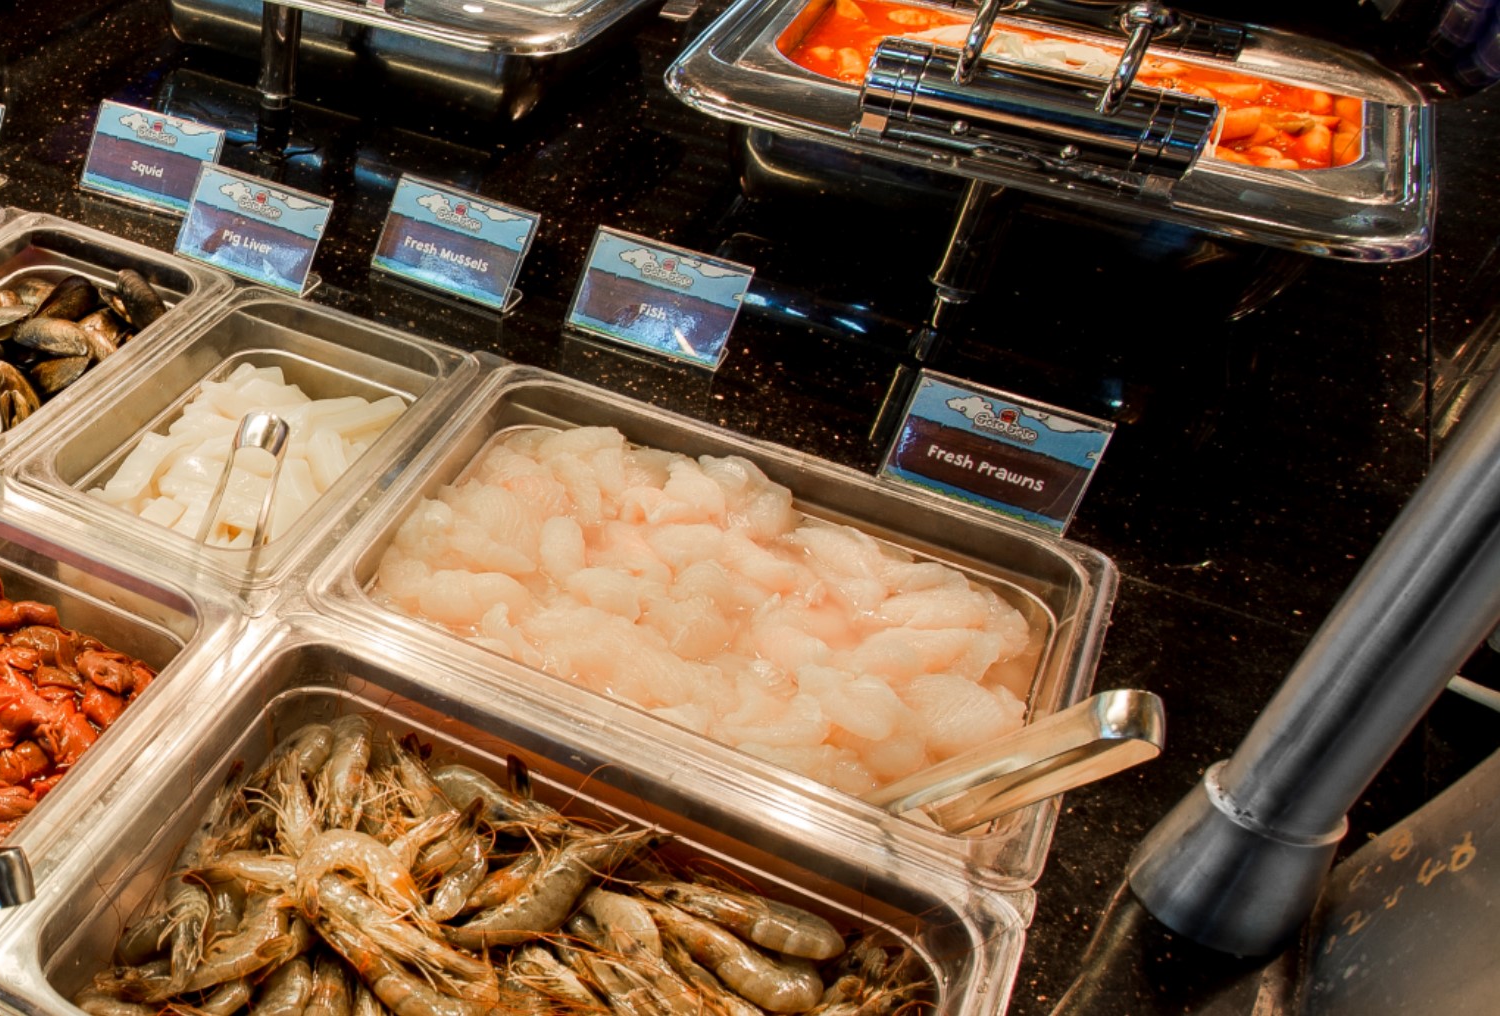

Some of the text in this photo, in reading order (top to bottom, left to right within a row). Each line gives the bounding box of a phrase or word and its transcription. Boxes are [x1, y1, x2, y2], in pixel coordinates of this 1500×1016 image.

[130, 160, 163, 178] Squid
[222, 229, 272, 254] Pig Liver
[403, 235, 489, 273] Fresh Mussels
[638, 302, 667, 321] Fish
[927, 445, 1045, 492] Fresh Prawns
